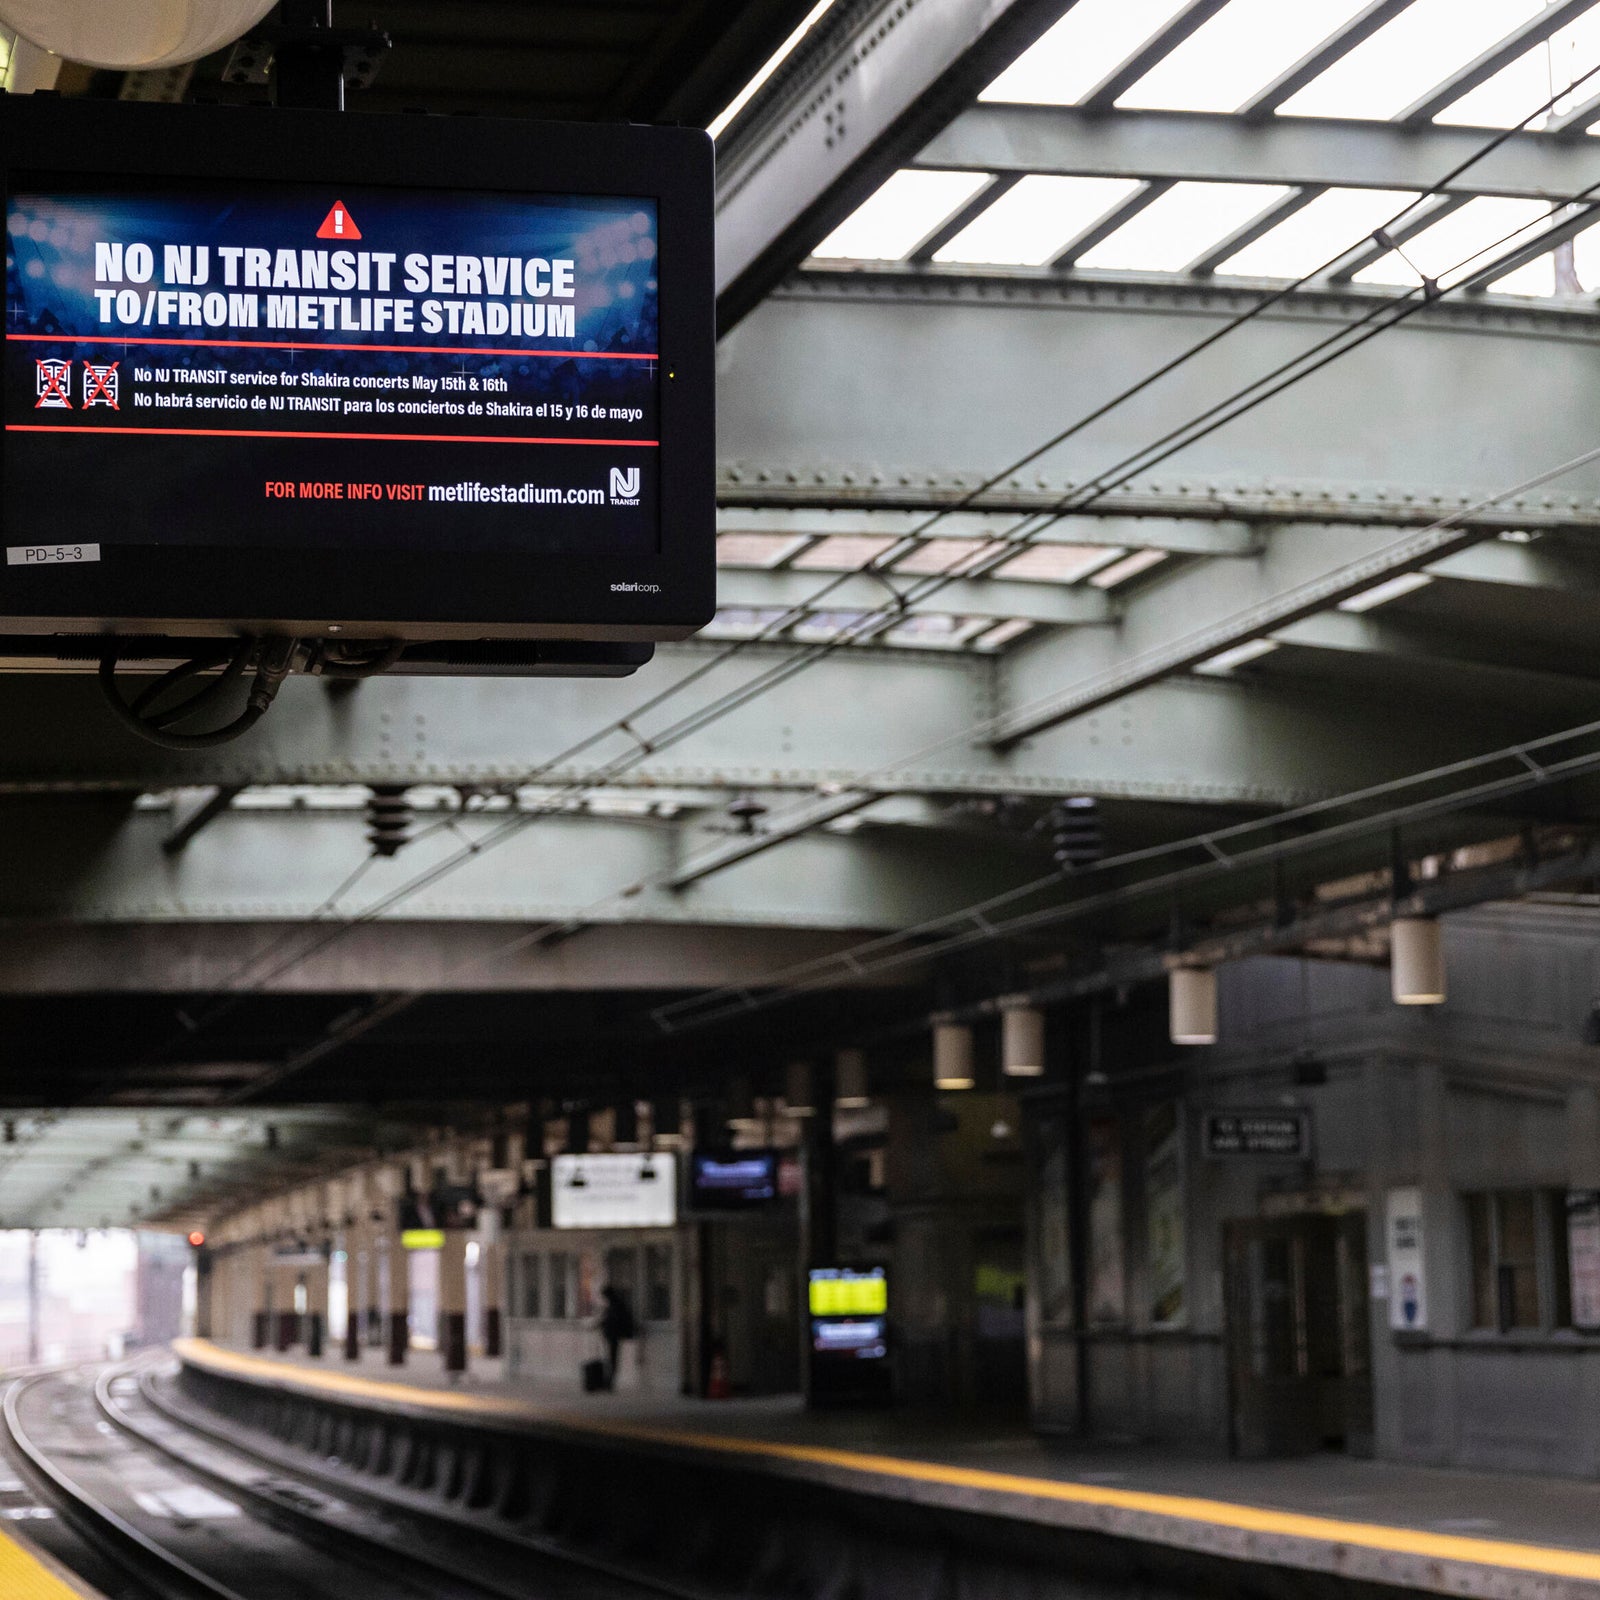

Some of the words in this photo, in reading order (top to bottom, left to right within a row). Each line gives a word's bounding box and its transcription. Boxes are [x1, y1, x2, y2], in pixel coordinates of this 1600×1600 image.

[95, 242, 154, 284] NO
[164, 245, 209, 285] NJ
[218, 247, 396, 292] TRANSIT
[404, 253, 575, 297] SERVICE
[94, 289, 259, 328] TO/FROM
[267, 295, 414, 333] METLIFE
[421, 300, 575, 337] STADIUM
[134, 368, 152, 382] No
[155, 369, 169, 383] NJ
[173, 369, 227, 384] TRANSIT
[230, 371, 277, 386] service
[280, 371, 298, 386] for
[301, 373, 350, 389] Shakira
[353, 376, 409, 390] concerts
[412, 376, 438, 393] May
[441, 377, 465, 390] 15th
[469, 378, 479, 391] &
[482, 378, 508, 391] 16th
[134, 393, 152, 407] No
[155, 393, 193, 408] habrá
[196, 394, 248, 409] servicio
[251, 395, 266, 410] de
[270, 396, 284, 410] NJ
[287, 397, 341, 412] TRANSIT
[344, 401, 372, 414] para
[376, 400, 394, 413] los
[397, 401, 465, 414] conciertos
[468, 402, 483, 415] de
[486, 403, 533, 417] Shakira
[536, 404, 547, 417] el
[550, 404, 563, 417] 15
[565, 407, 572, 420] y
[576, 405, 588, 418] 16
[591, 406, 606, 419] de
[609, 408, 643, 421] mayo
[265, 482, 295, 498] FOR
[300, 483, 343, 499] MORE
[348, 484, 382, 500] INFO
[386, 484, 425, 500] VISIT
[428, 483, 604, 504] metlifestadium.com
[609, 467, 640, 497] NJ
[25, 547, 83, 562] PD-5-3
